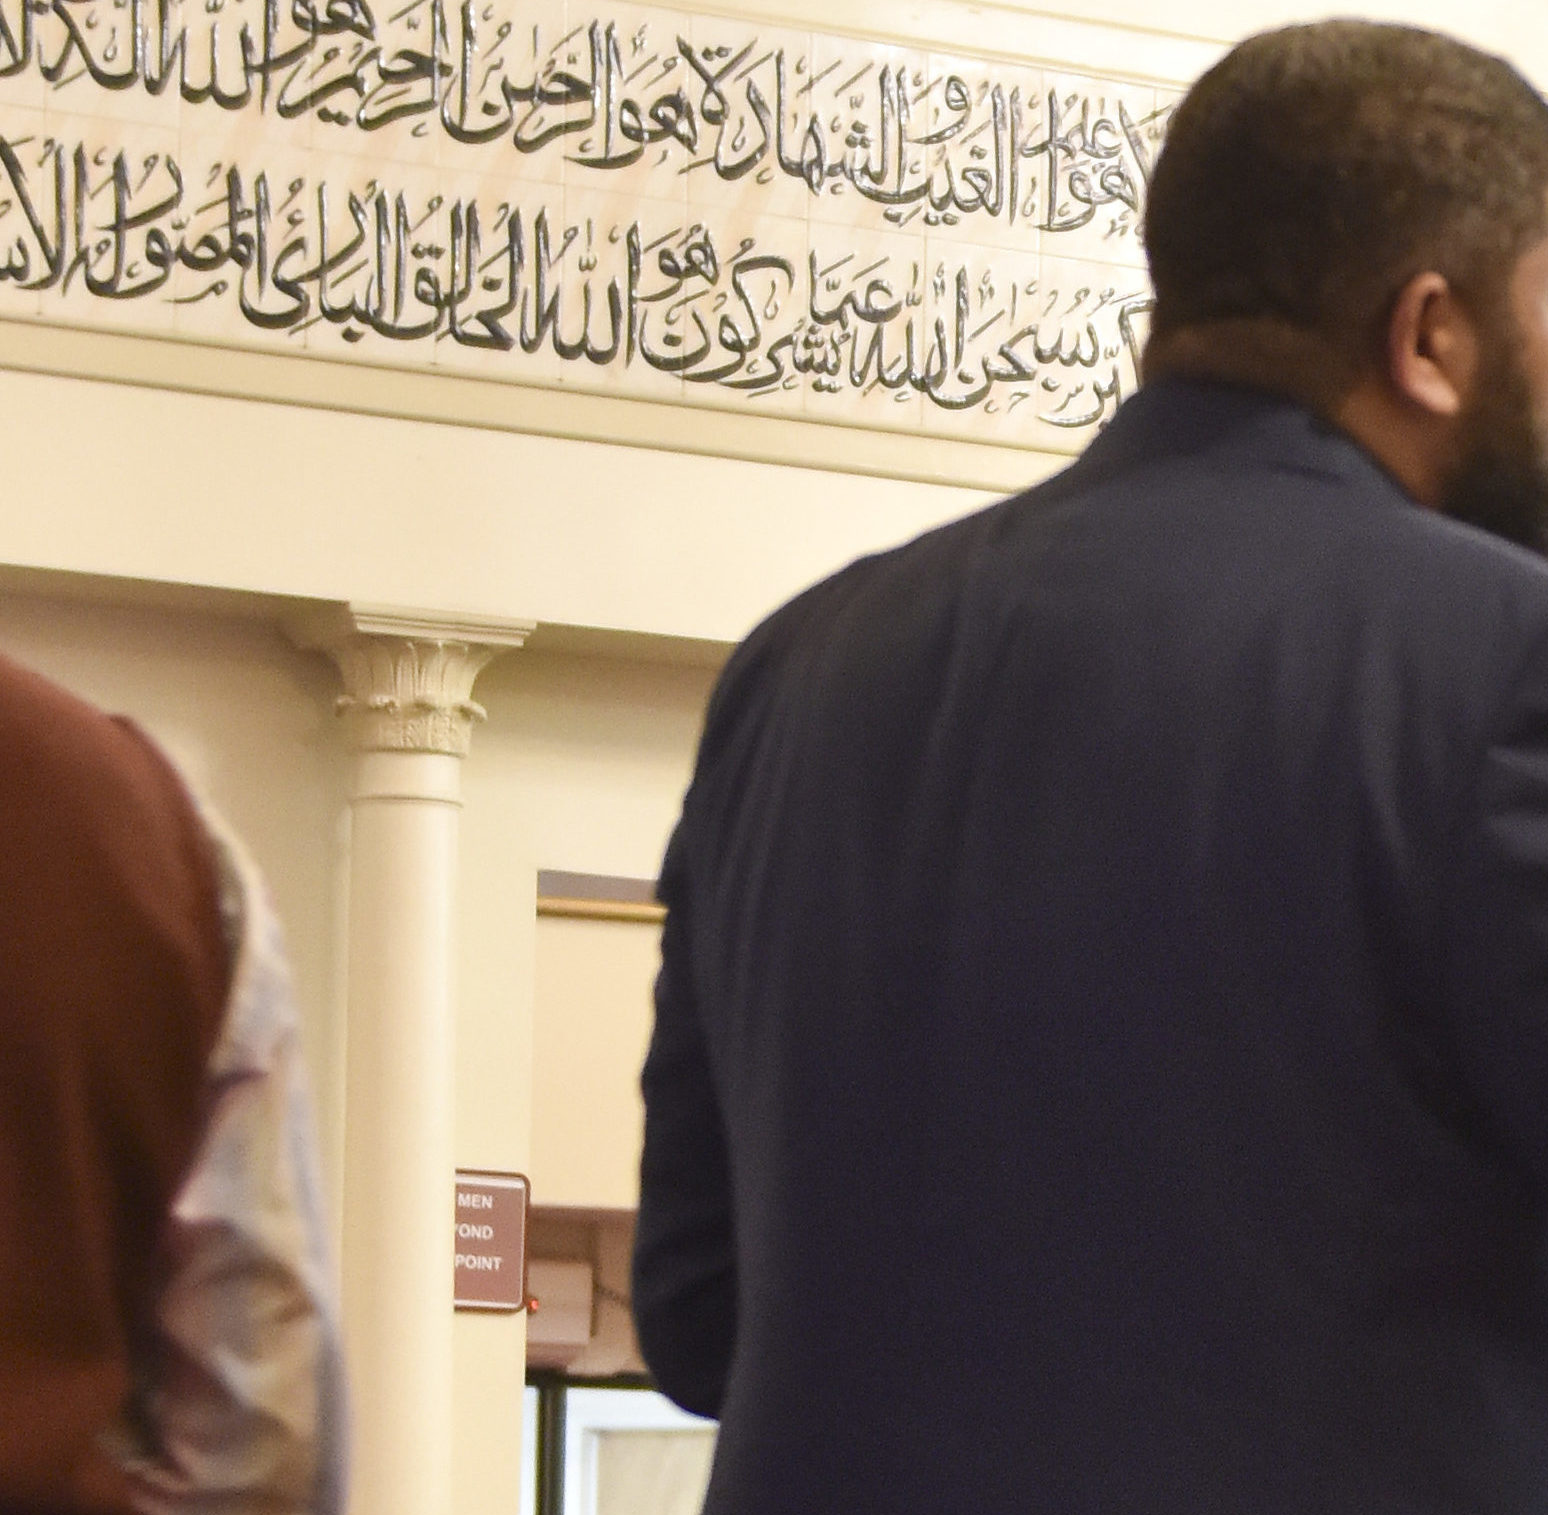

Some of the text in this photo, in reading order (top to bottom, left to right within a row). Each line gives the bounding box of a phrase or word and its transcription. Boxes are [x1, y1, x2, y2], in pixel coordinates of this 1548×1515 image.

[457, 1193, 493, 1209] MEN
[455, 1223, 494, 1240] OND
[455, 1254, 502, 1270] POINT
